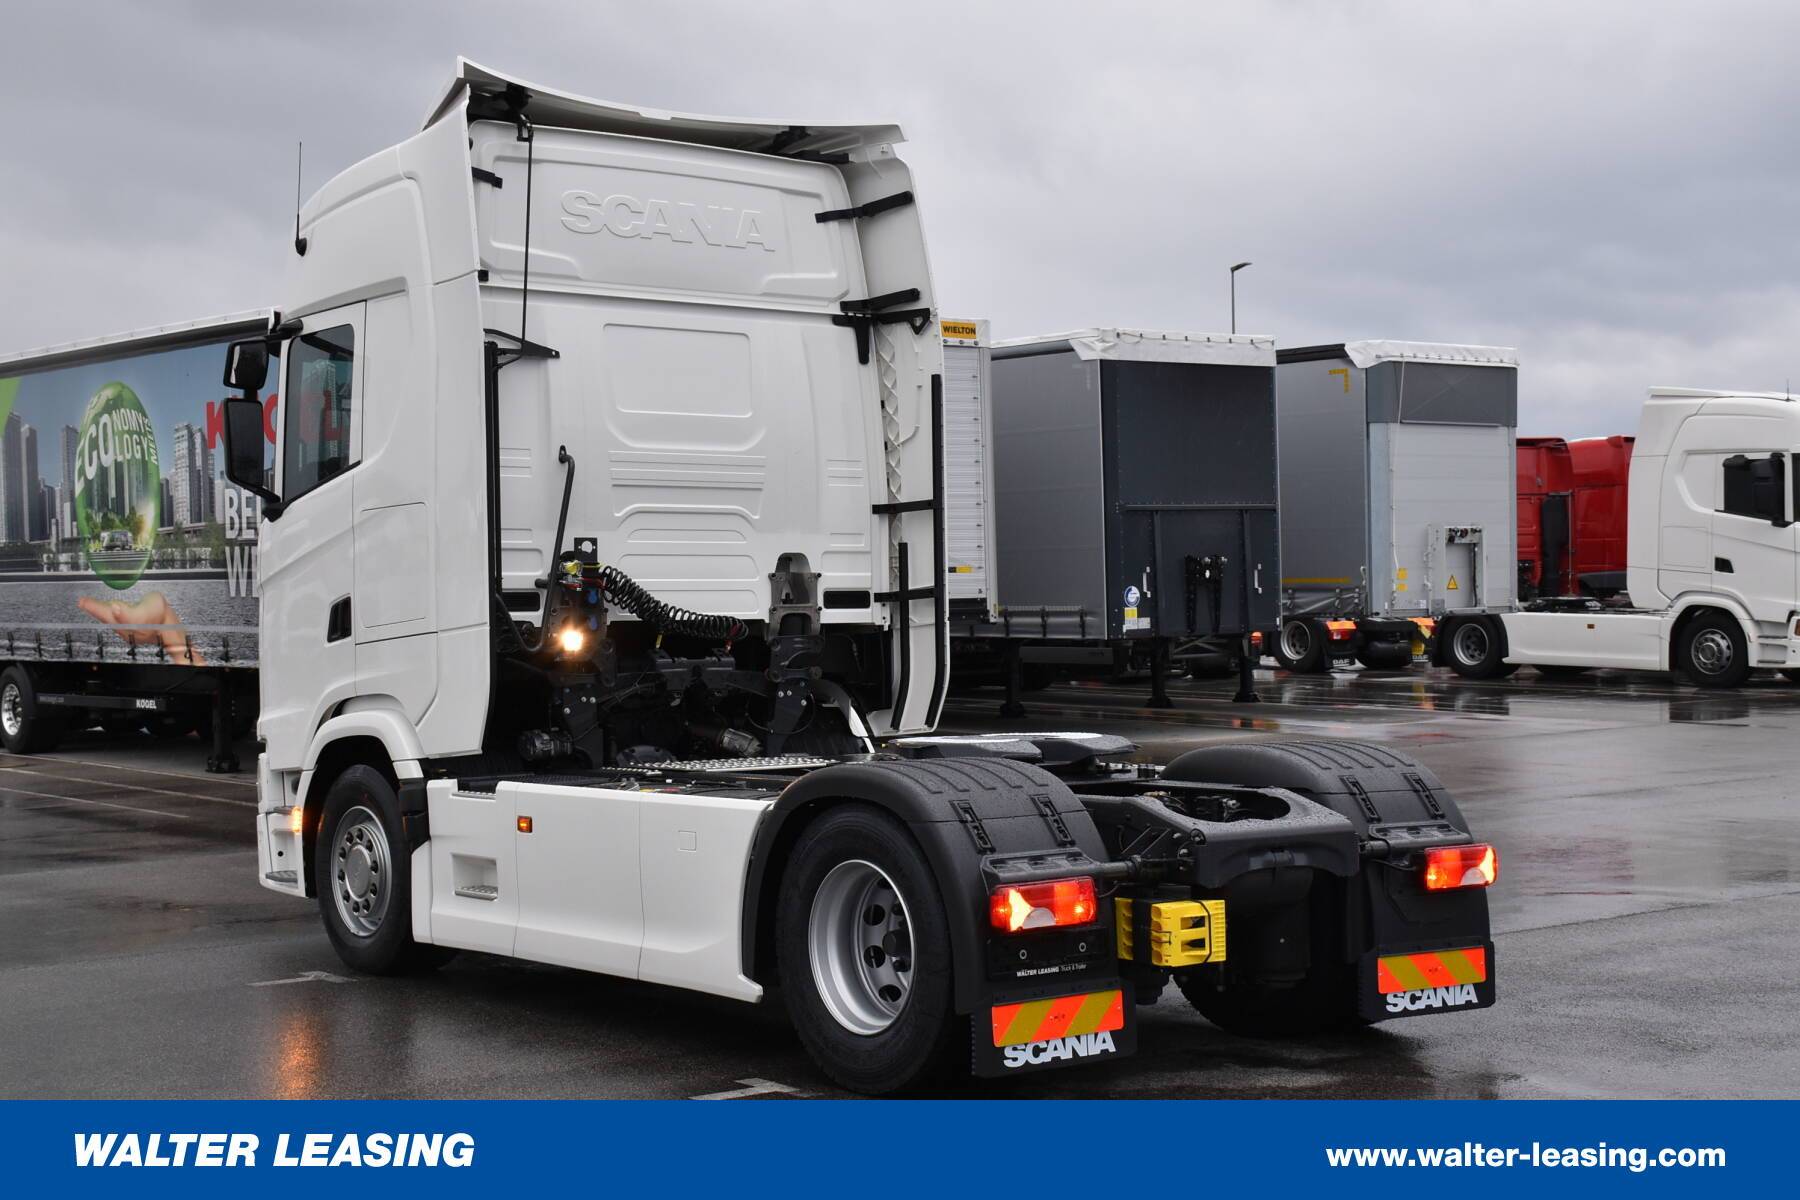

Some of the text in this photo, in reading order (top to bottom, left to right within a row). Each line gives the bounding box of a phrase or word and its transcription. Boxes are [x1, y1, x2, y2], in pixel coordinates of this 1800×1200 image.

[560, 189, 776, 252] SCANIA
[943, 325, 976, 335] WIELTON
[112, 408, 145, 433] NOMY
[75, 413, 114, 498] ECO
[115, 434, 149, 462] LOGY
[1016, 969, 1037, 977] WALTER
[1038, 966, 1060, 975] LEASING
[1385, 983, 1478, 1013] SCANIA
[1003, 1030, 1116, 1068] SCANIA
